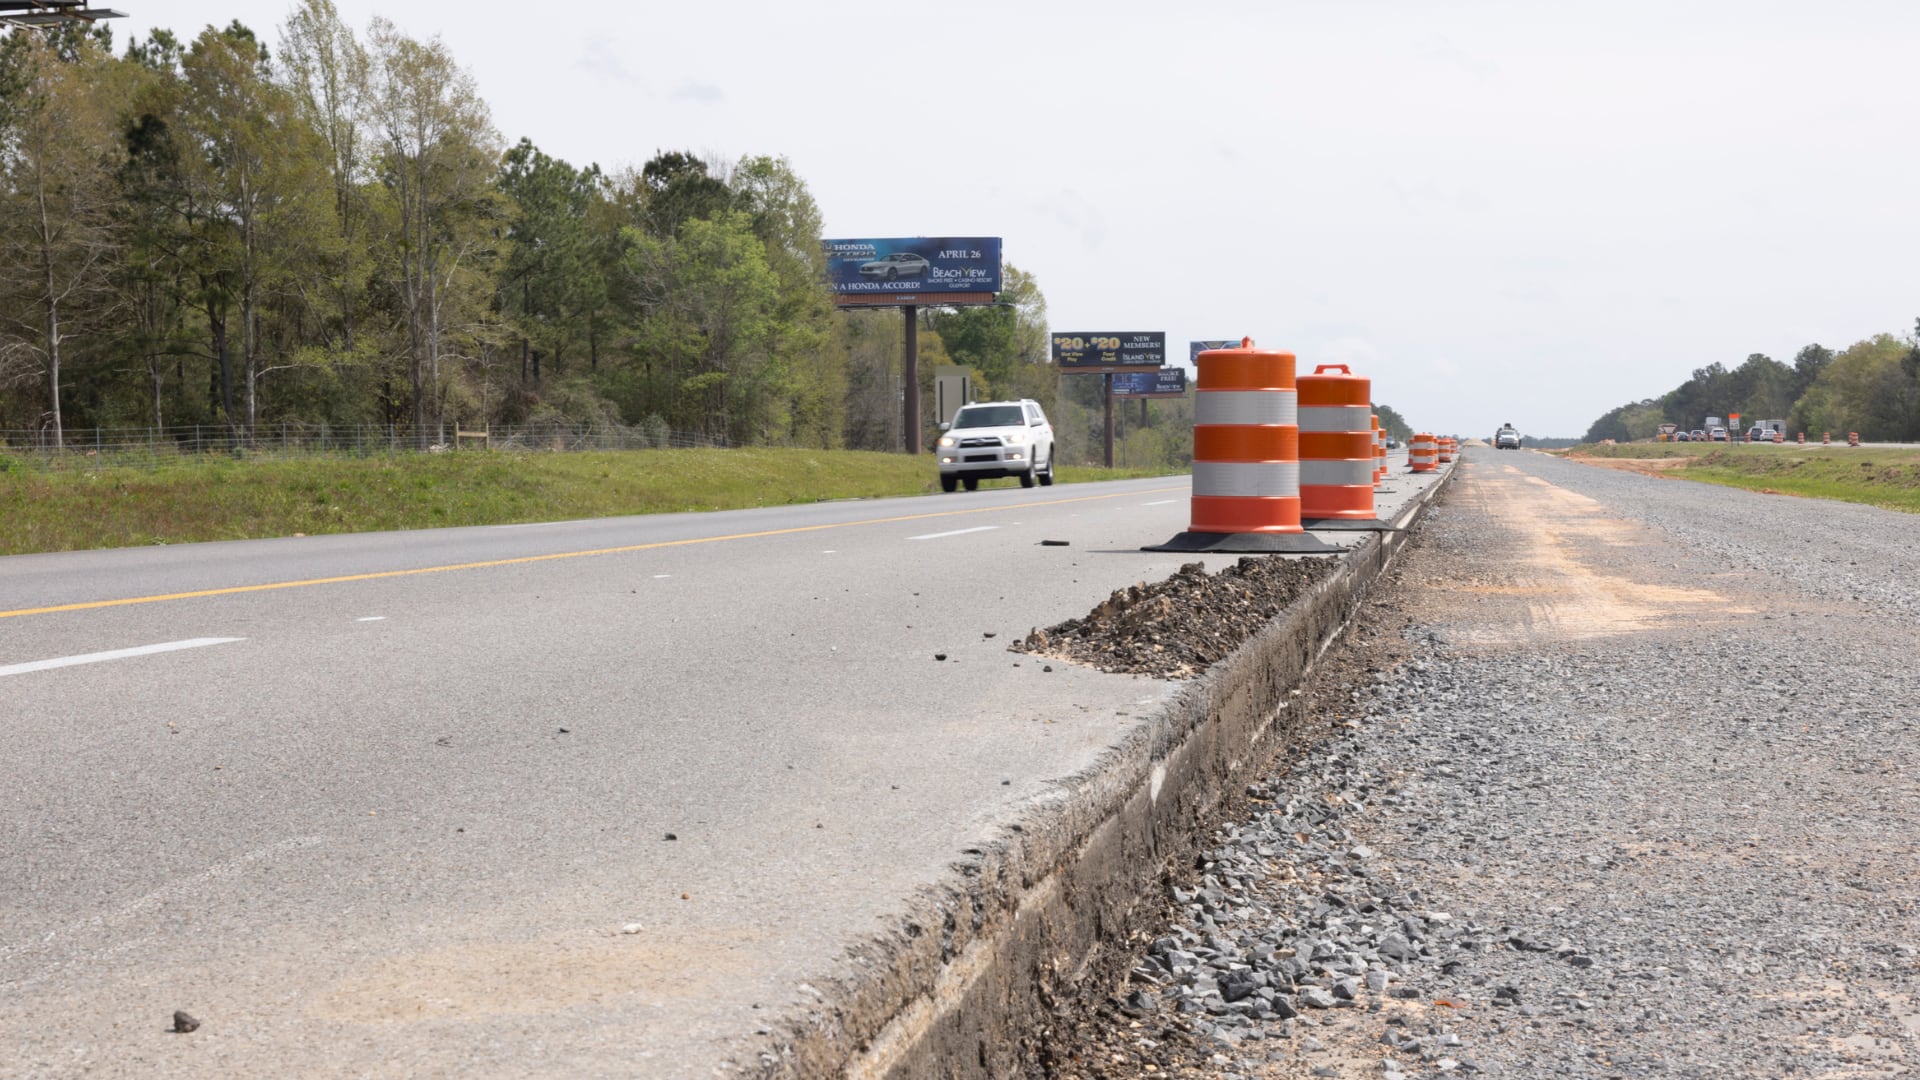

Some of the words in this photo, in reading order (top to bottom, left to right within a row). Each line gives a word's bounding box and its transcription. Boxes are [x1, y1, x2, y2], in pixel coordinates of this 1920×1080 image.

[938, 250, 969, 259] APRIL
[970, 250, 981, 258] 26
[839, 282, 846, 290] A
[848, 282, 880, 290] HONDA
[882, 281, 920, 289] ACCORD!
[1054, 336, 1084, 349] $20
[1090, 336, 1120, 349] $20
